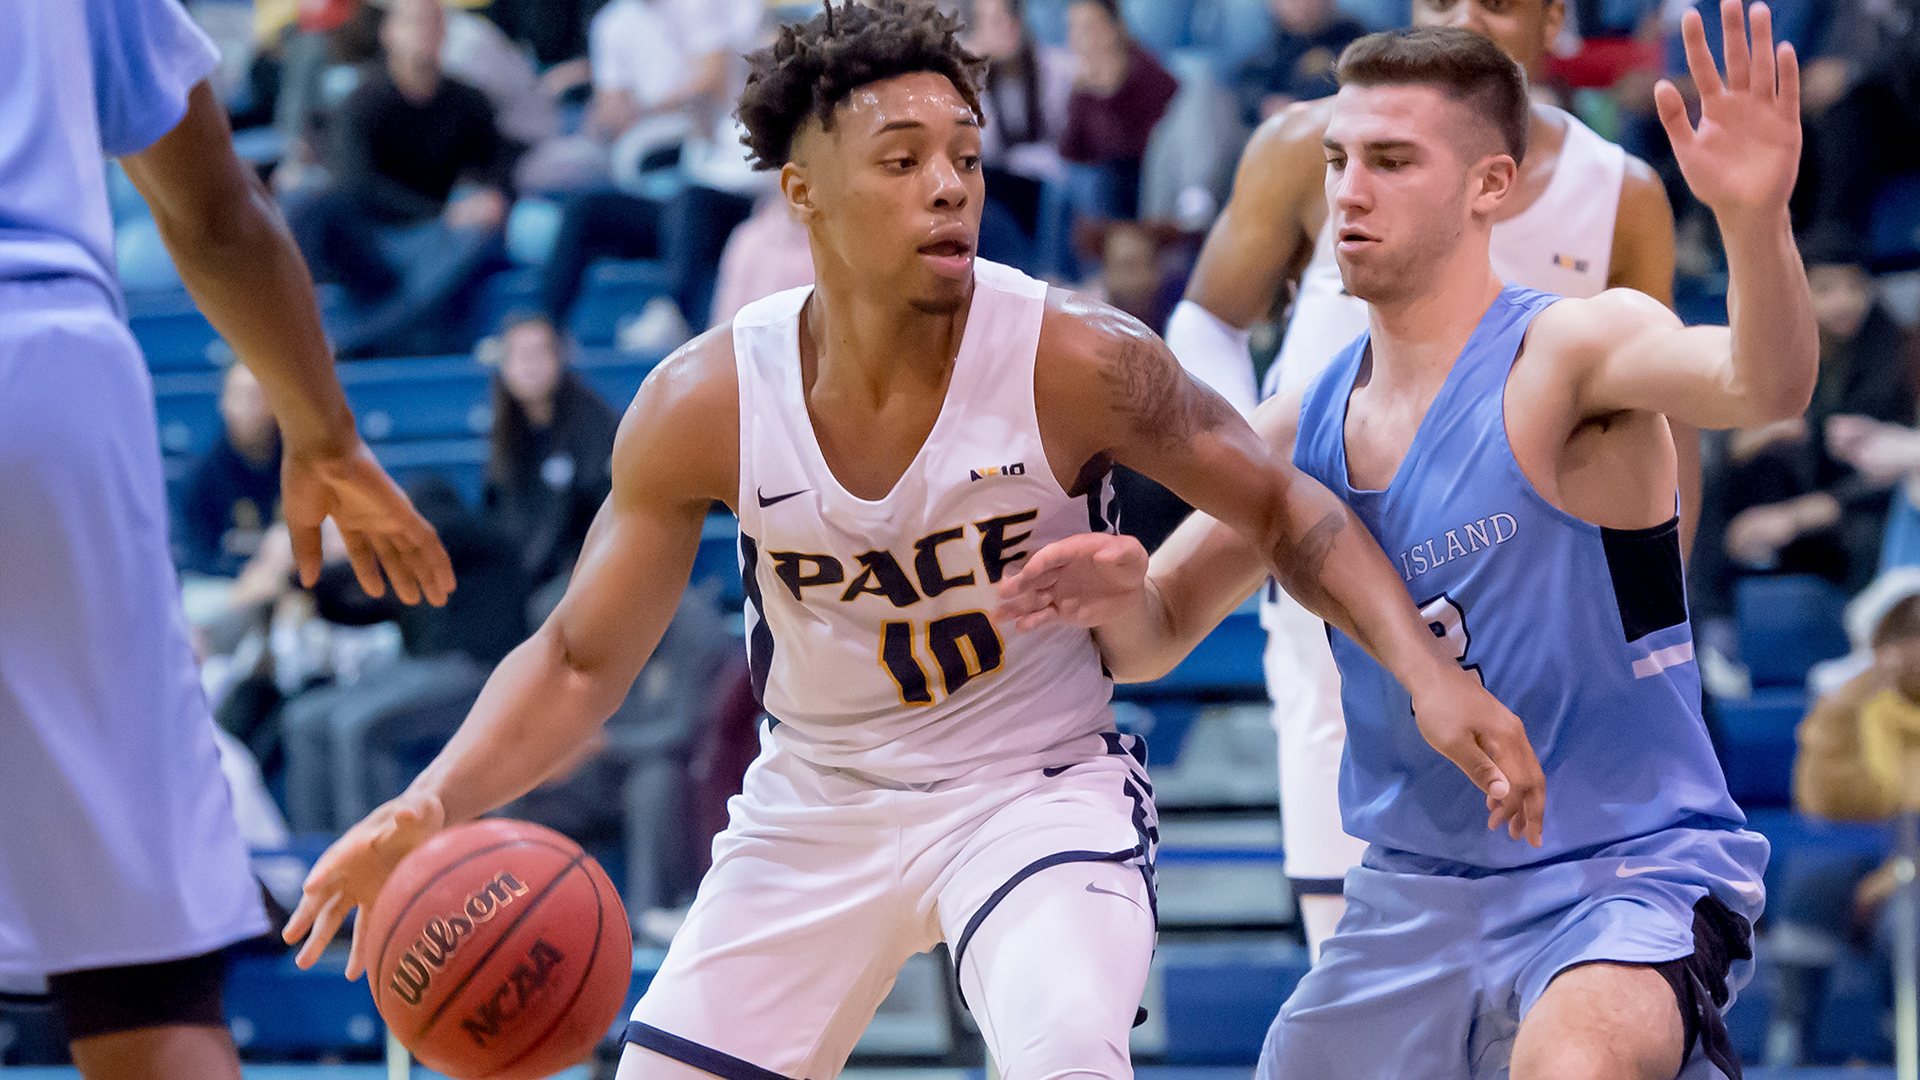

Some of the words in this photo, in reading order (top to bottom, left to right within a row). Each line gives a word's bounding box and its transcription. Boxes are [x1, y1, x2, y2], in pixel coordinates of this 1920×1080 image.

[765, 509, 1039, 607] PACE
[1400, 512, 1518, 582] ISLAND
[878, 609, 1004, 706] 10
[390, 870, 528, 1005] Wilson
[460, 938, 563, 1047] NCAA
